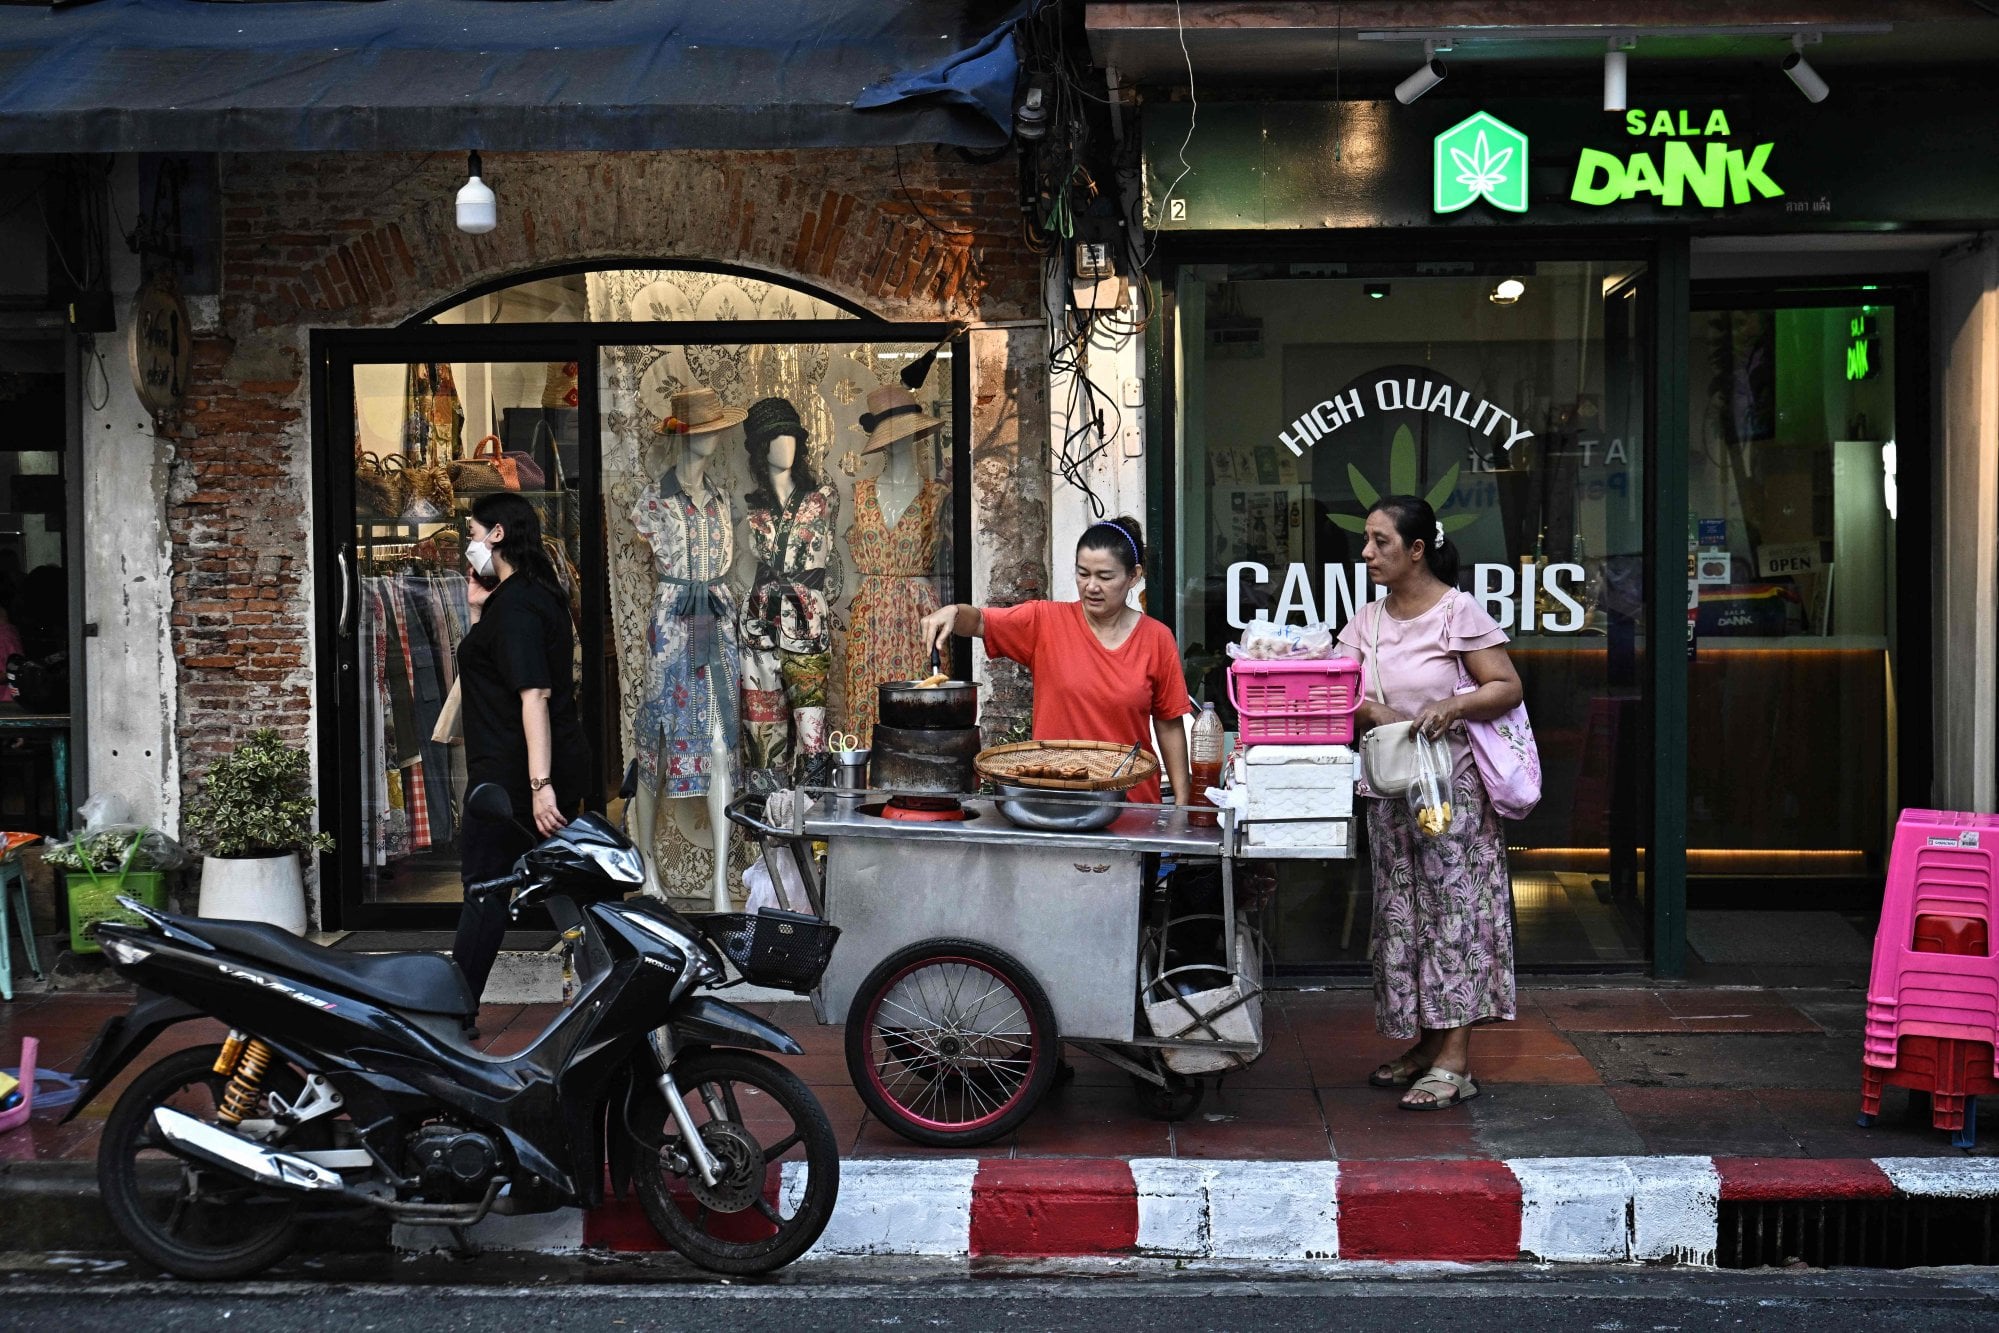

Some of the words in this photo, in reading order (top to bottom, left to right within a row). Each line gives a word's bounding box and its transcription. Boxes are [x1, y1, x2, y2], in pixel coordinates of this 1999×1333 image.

[1626, 109, 1731, 137] SALA
[1570, 141, 1784, 208] DANK
[1173, 201, 1185, 219] 2
[1278, 388, 1365, 457] HIGH
[1375, 378, 1535, 450] QUALITY
[1769, 556, 1811, 573] OPEN
[1226, 561, 1585, 632] CANBIS
[1717, 614, 1753, 626] DANK
[644, 956, 676, 973] HONDA
